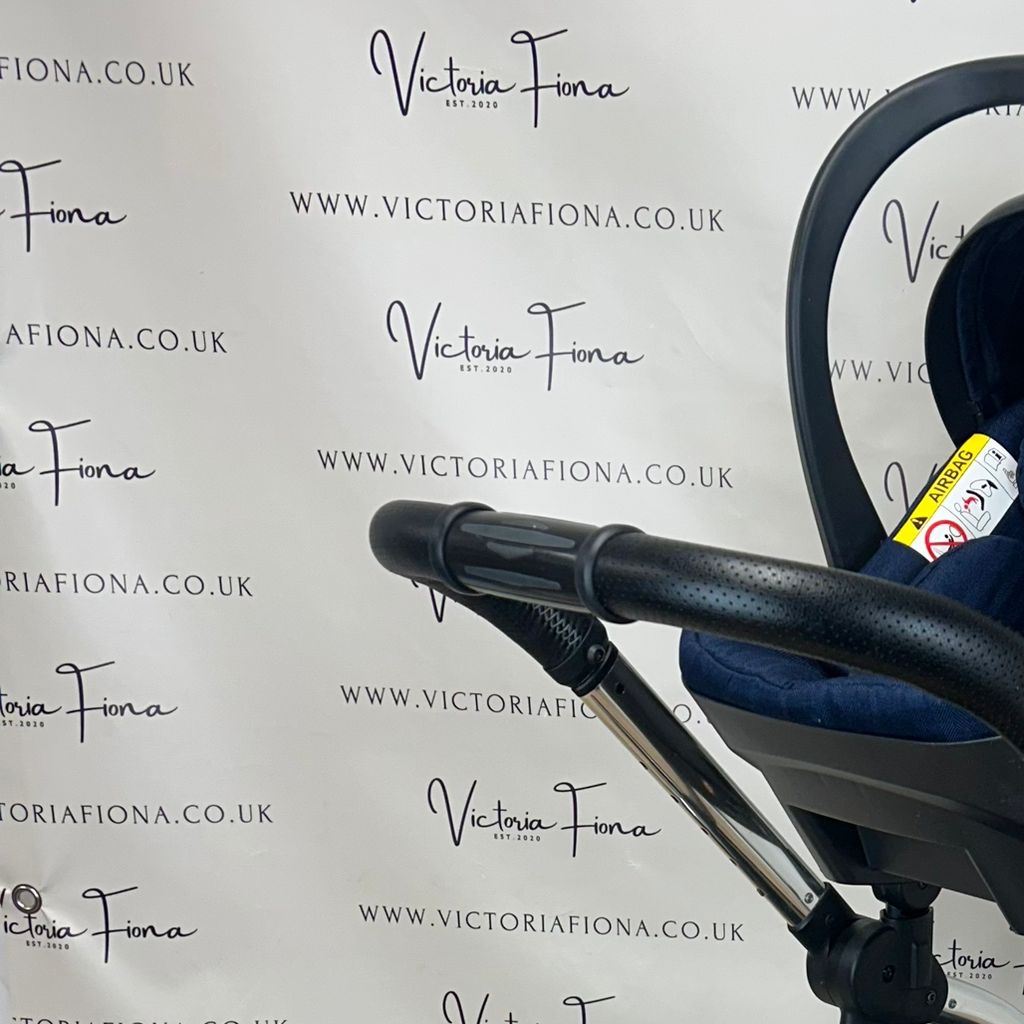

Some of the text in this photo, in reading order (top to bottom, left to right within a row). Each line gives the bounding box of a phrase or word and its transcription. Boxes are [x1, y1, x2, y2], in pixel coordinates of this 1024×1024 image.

[369, 28, 631, 129] Victoria Fiona
[445, 99, 498, 109] EST.2020
[0, 159, 128, 253] Fiona
[289, 191, 725, 232] WWW.VICTORIAFIONA.CO.UK
[385, 299, 645, 392] Victoria Fiona
[459, 364, 512, 374] EST.2020
[27, 418, 157, 507] Fiona
[316, 449, 734, 489] WWW.VICTORIAFIONA.CO.UK
[929, 450, 973, 503] AIRBAG
[0, 570, 254, 598] RIAFIONA.CO.UK
[54, 660, 179, 744] Fiona
[426, 777, 662, 859] Victoria Fiona
[81, 885, 199, 964] Fiona
[358, 904, 745, 942] WWW.VICTORIAFIONA.CO.UK
